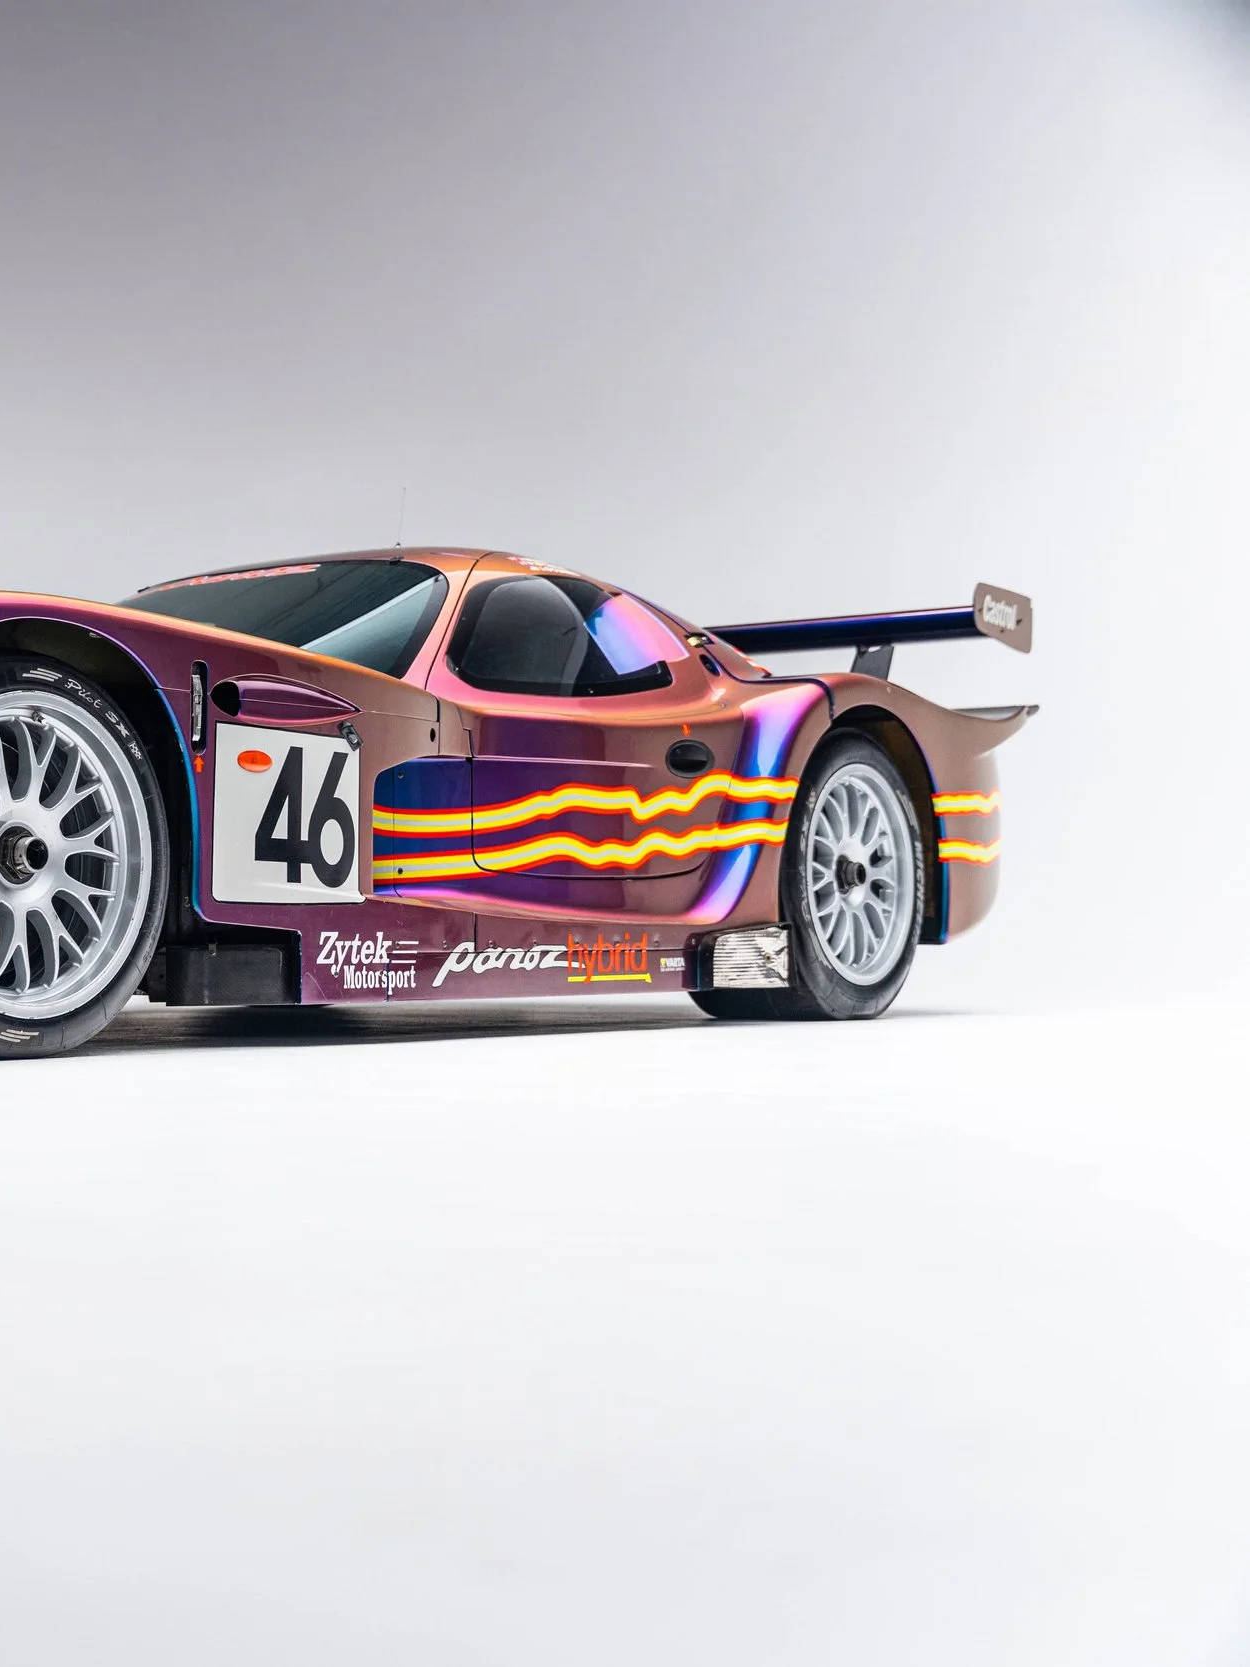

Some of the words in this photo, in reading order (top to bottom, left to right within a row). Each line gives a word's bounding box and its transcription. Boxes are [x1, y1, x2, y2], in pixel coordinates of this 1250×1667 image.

[983, 594, 1018, 631] Castrol
[65, 678, 103, 708] Pilot
[105, 710, 130, 738] SX
[254, 746, 355, 888] 46
[316, 931, 394, 975] Zytek
[567, 932, 648, 984] hybrid
[343, 965, 417, 995] Motorsport
